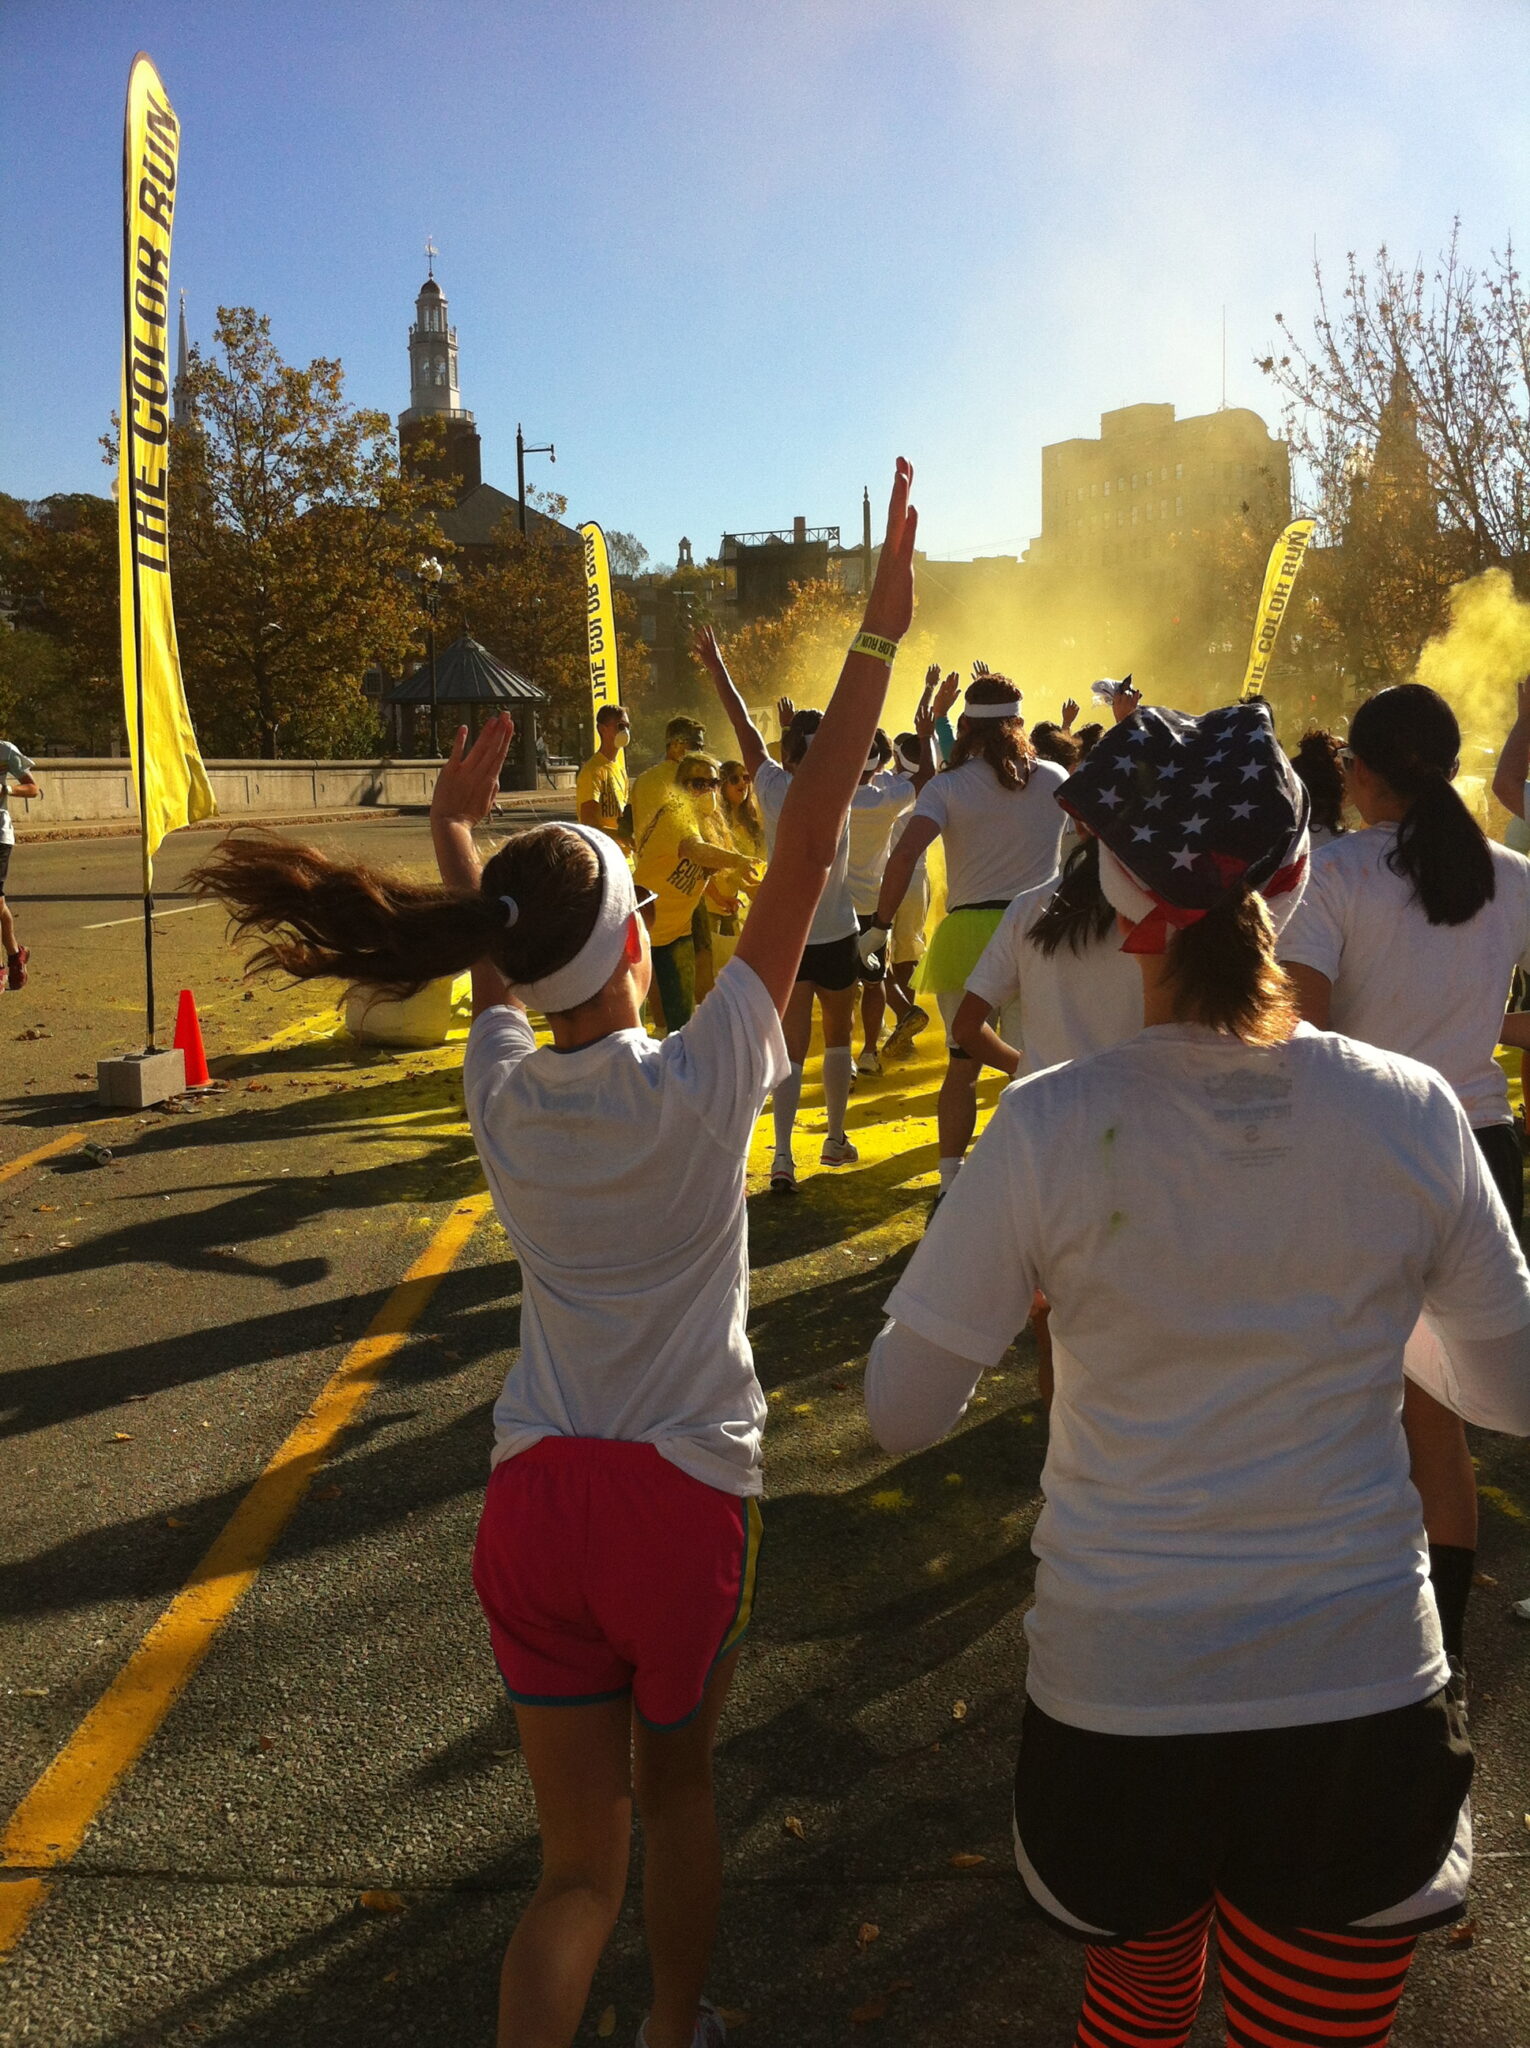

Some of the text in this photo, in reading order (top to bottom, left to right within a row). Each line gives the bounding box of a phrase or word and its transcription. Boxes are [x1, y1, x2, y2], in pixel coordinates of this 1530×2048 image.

[132, 88, 177, 573] THE COLOR RUN
[1258, 582, 1290, 653] COLOR
[1281, 530, 1308, 578] RUN
[861, 635, 878, 650] RUN
[666, 870, 697, 896] RUN
